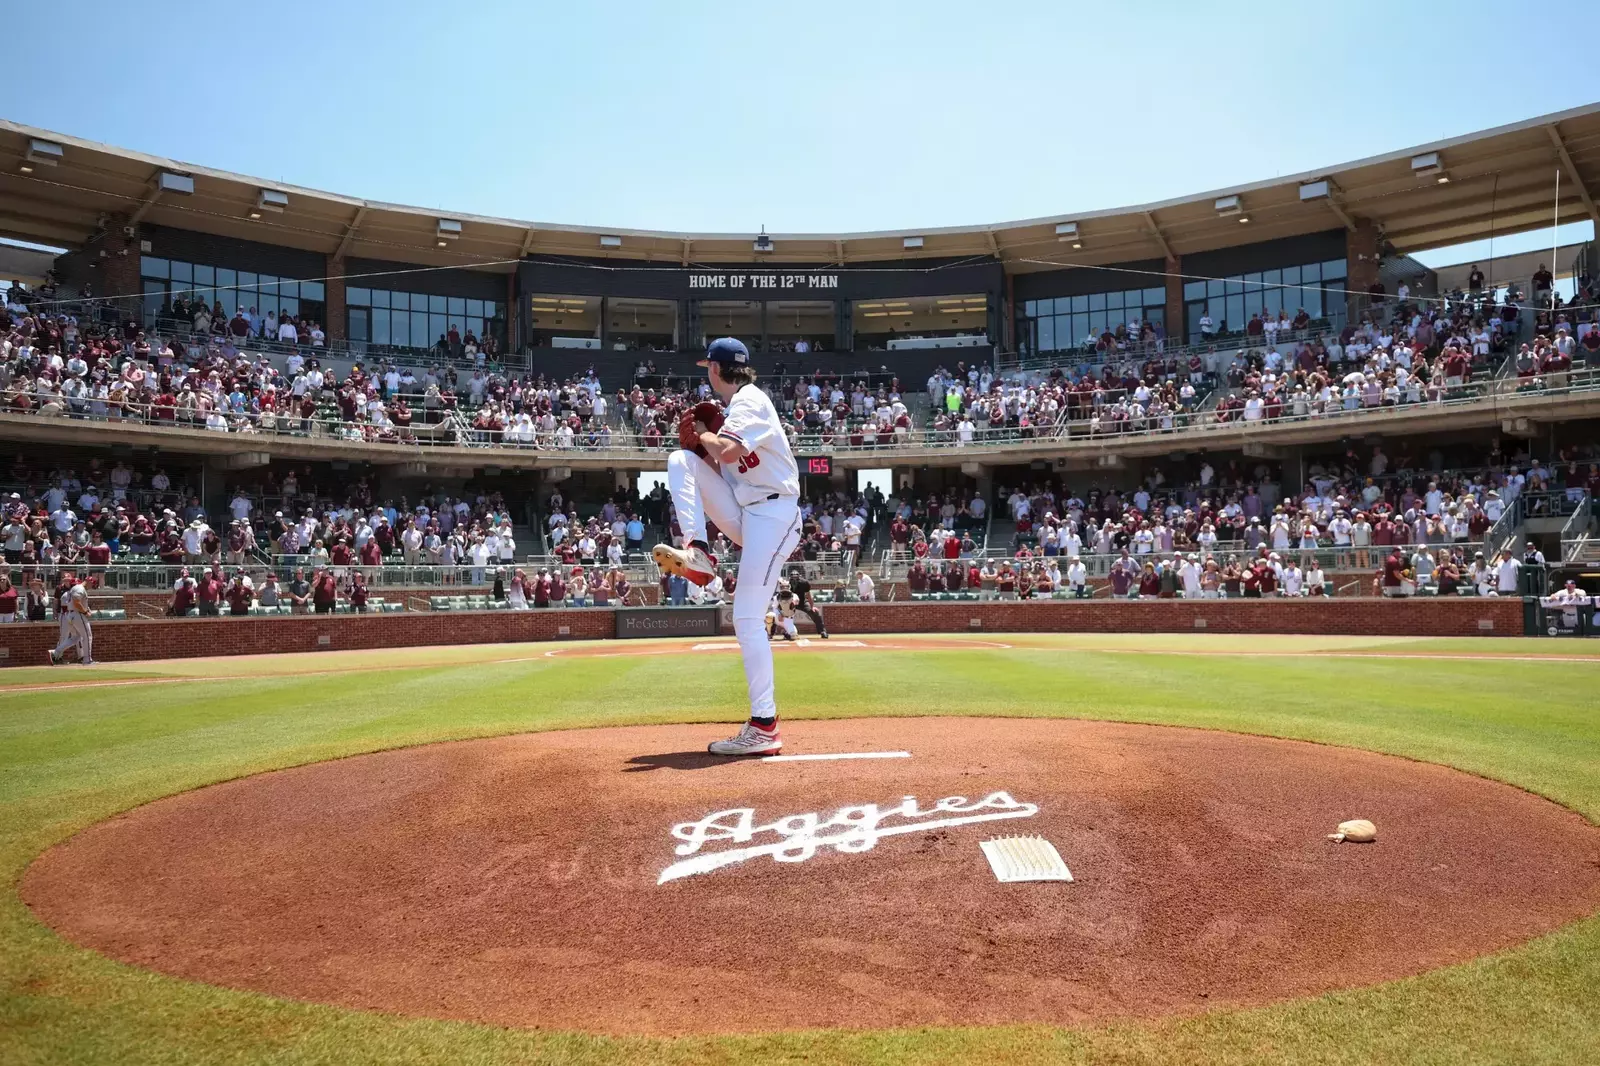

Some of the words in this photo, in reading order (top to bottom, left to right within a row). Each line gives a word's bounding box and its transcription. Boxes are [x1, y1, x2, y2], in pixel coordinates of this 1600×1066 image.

[689, 275, 726, 288] HOME
[730, 275, 746, 288] OF
[750, 275, 777, 288] THE
[780, 275, 806, 288] 12TH
[808, 275, 839, 288] MAN
[808, 459, 829, 473] 155
[626, 617, 709, 630] HeGetsUs.com
[669, 791, 1038, 864] Aggies
